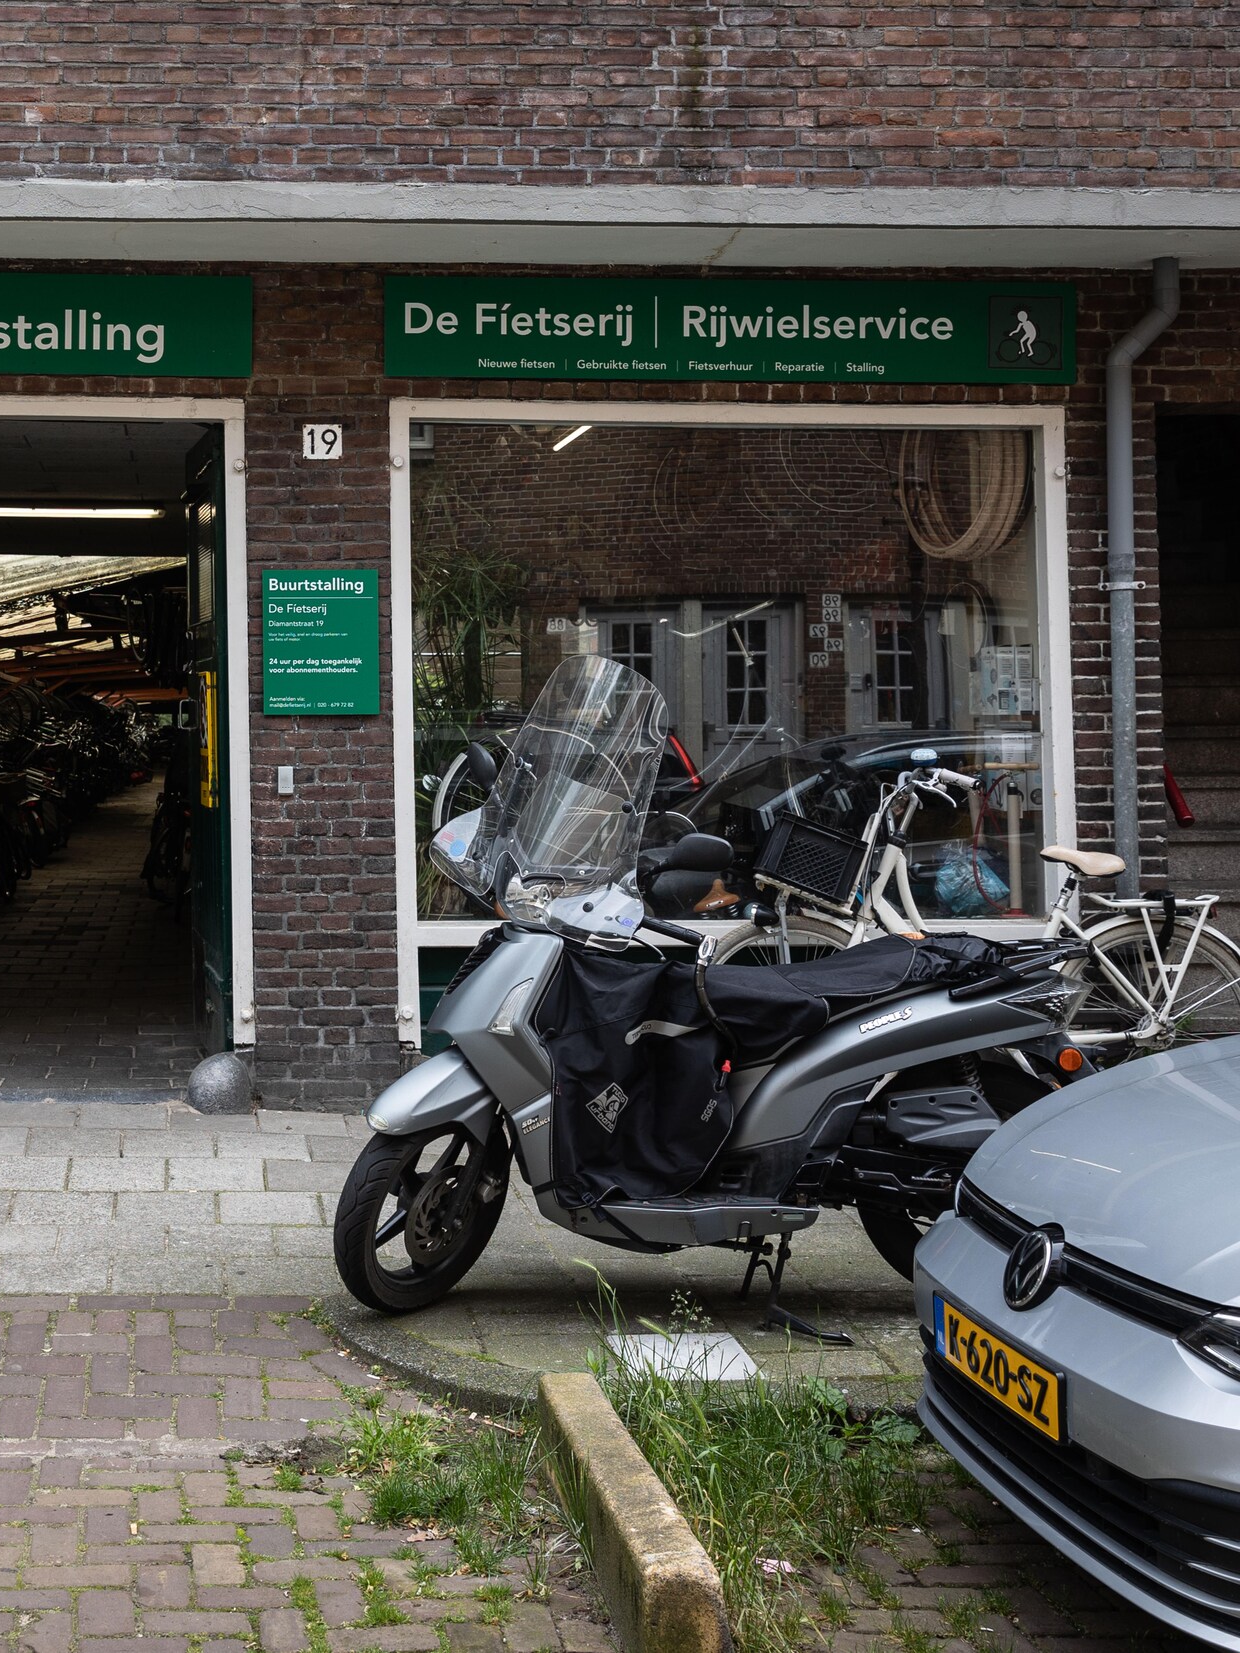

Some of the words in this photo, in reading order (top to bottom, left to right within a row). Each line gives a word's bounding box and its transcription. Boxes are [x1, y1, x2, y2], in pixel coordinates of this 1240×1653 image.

[404, 302, 459, 335] De
[683, 304, 954, 348] Rijwielservice
[478, 358, 518, 369] Nieuwe
[520, 358, 555, 369] fietsen
[576, 359, 629, 370] Gebruikte
[631, 359, 667, 370] fietsen
[688, 360, 753, 371] Fietsverhuur
[775, 361, 825, 374] Reparatie
[846, 362, 885, 375] Stalling
[307, 428, 338, 455] 19
[268, 578, 364, 594] Buurtstalling
[268, 604, 284, 614] De
[268, 620, 314, 628] Diamantstraat
[306, 658, 319, 666] dag
[321, 658, 362, 666] toegankelijk
[948, 1313, 1050, 1427] K-620-SZ
